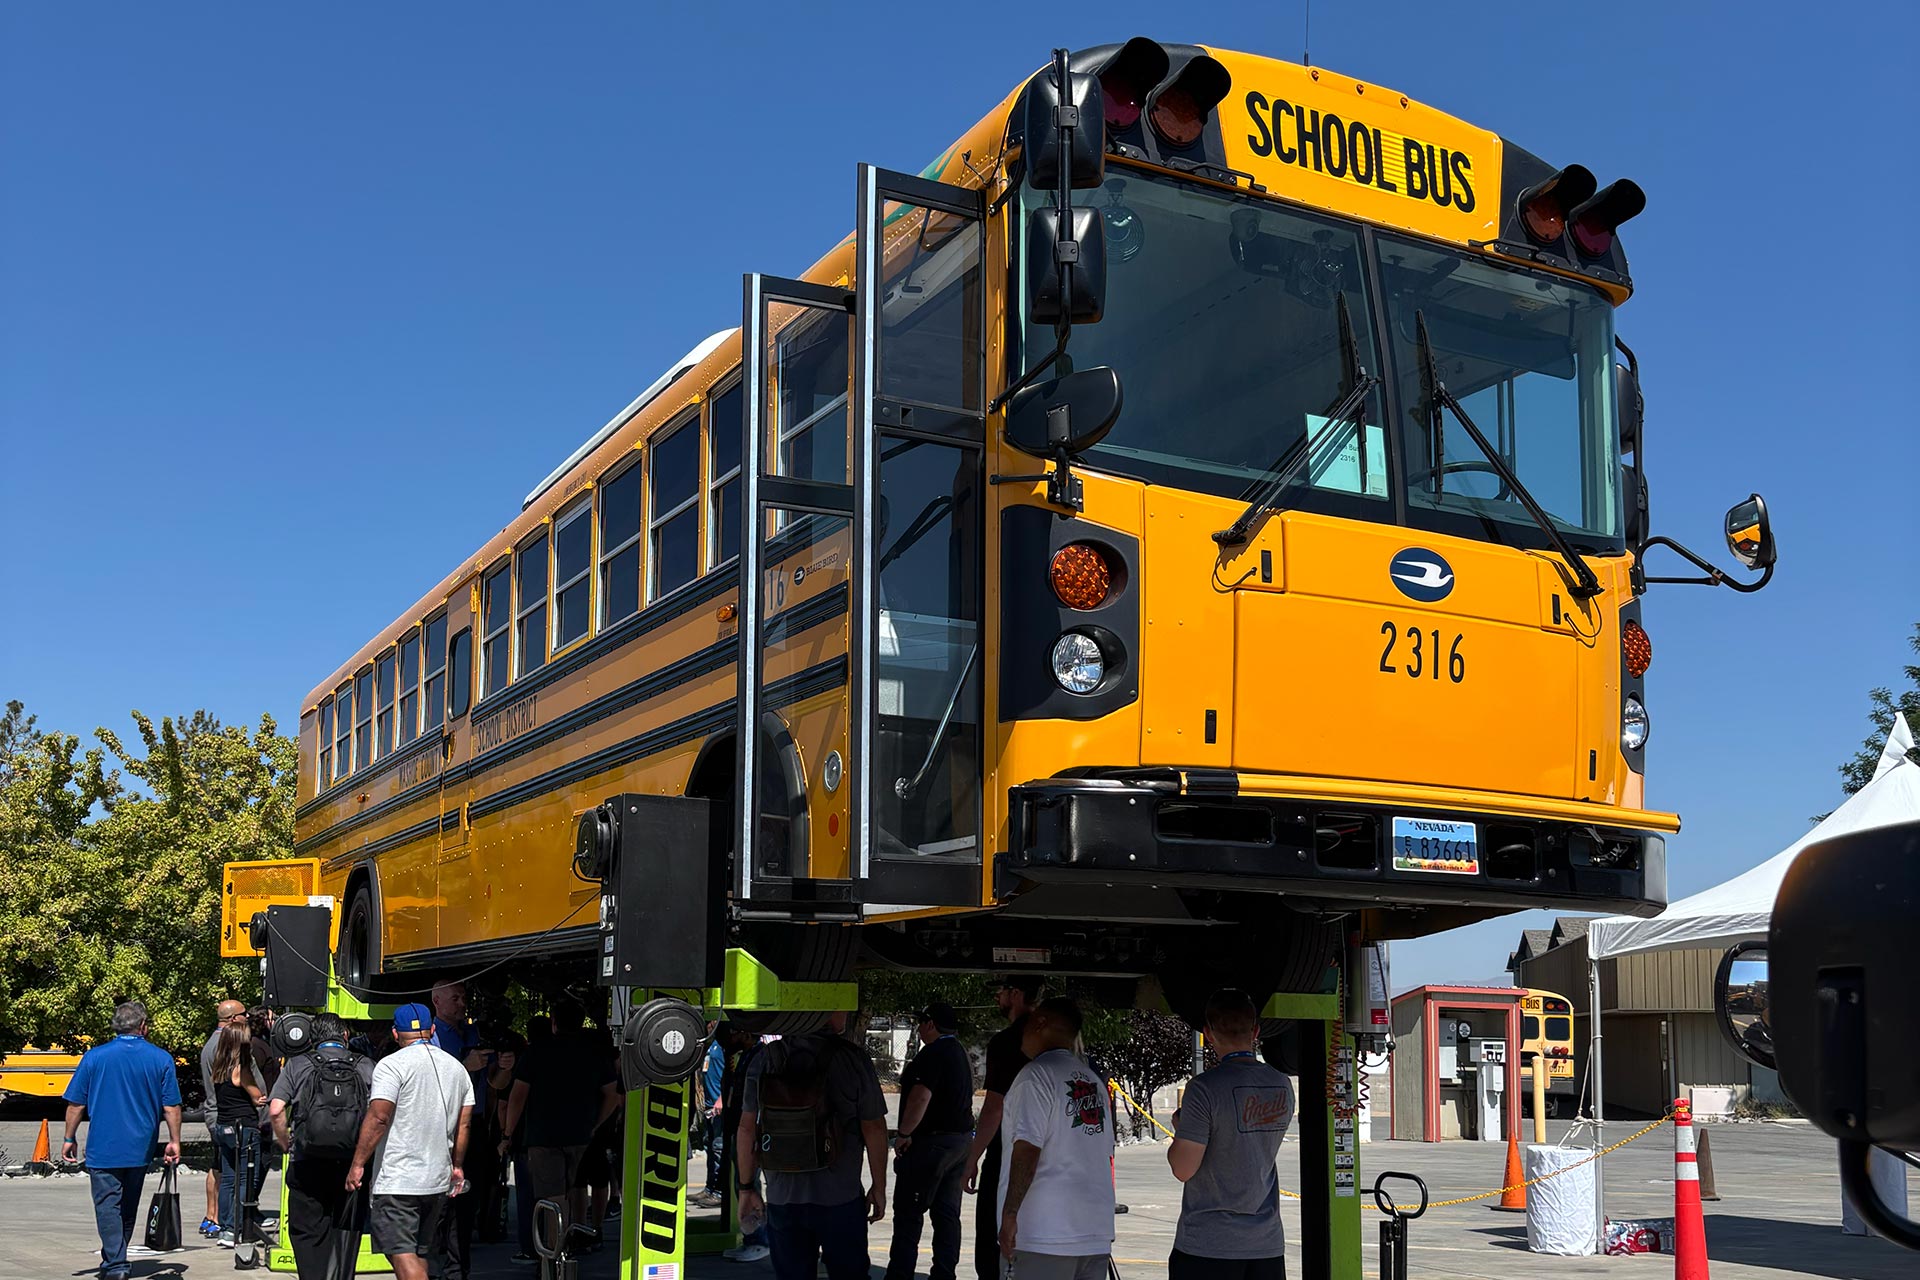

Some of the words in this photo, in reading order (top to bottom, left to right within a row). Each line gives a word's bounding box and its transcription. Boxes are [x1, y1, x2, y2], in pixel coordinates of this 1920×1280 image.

[1245, 91, 1397, 193] SCHOOL
[1403, 137, 1476, 213] BUS
[769, 564, 784, 610] 16
[806, 560, 822, 576] BLUE
[823, 552, 839, 568] BIRD
[1379, 620, 1465, 684] 2316
[477, 714, 503, 753] SCHOOL
[506, 694, 538, 739] DISTRICT
[1414, 822, 1455, 833] NEVADA
[1421, 837, 1474, 862] 83661
[1525, 999, 1540, 1010] BUS
[641, 1083, 684, 1254] BRID
